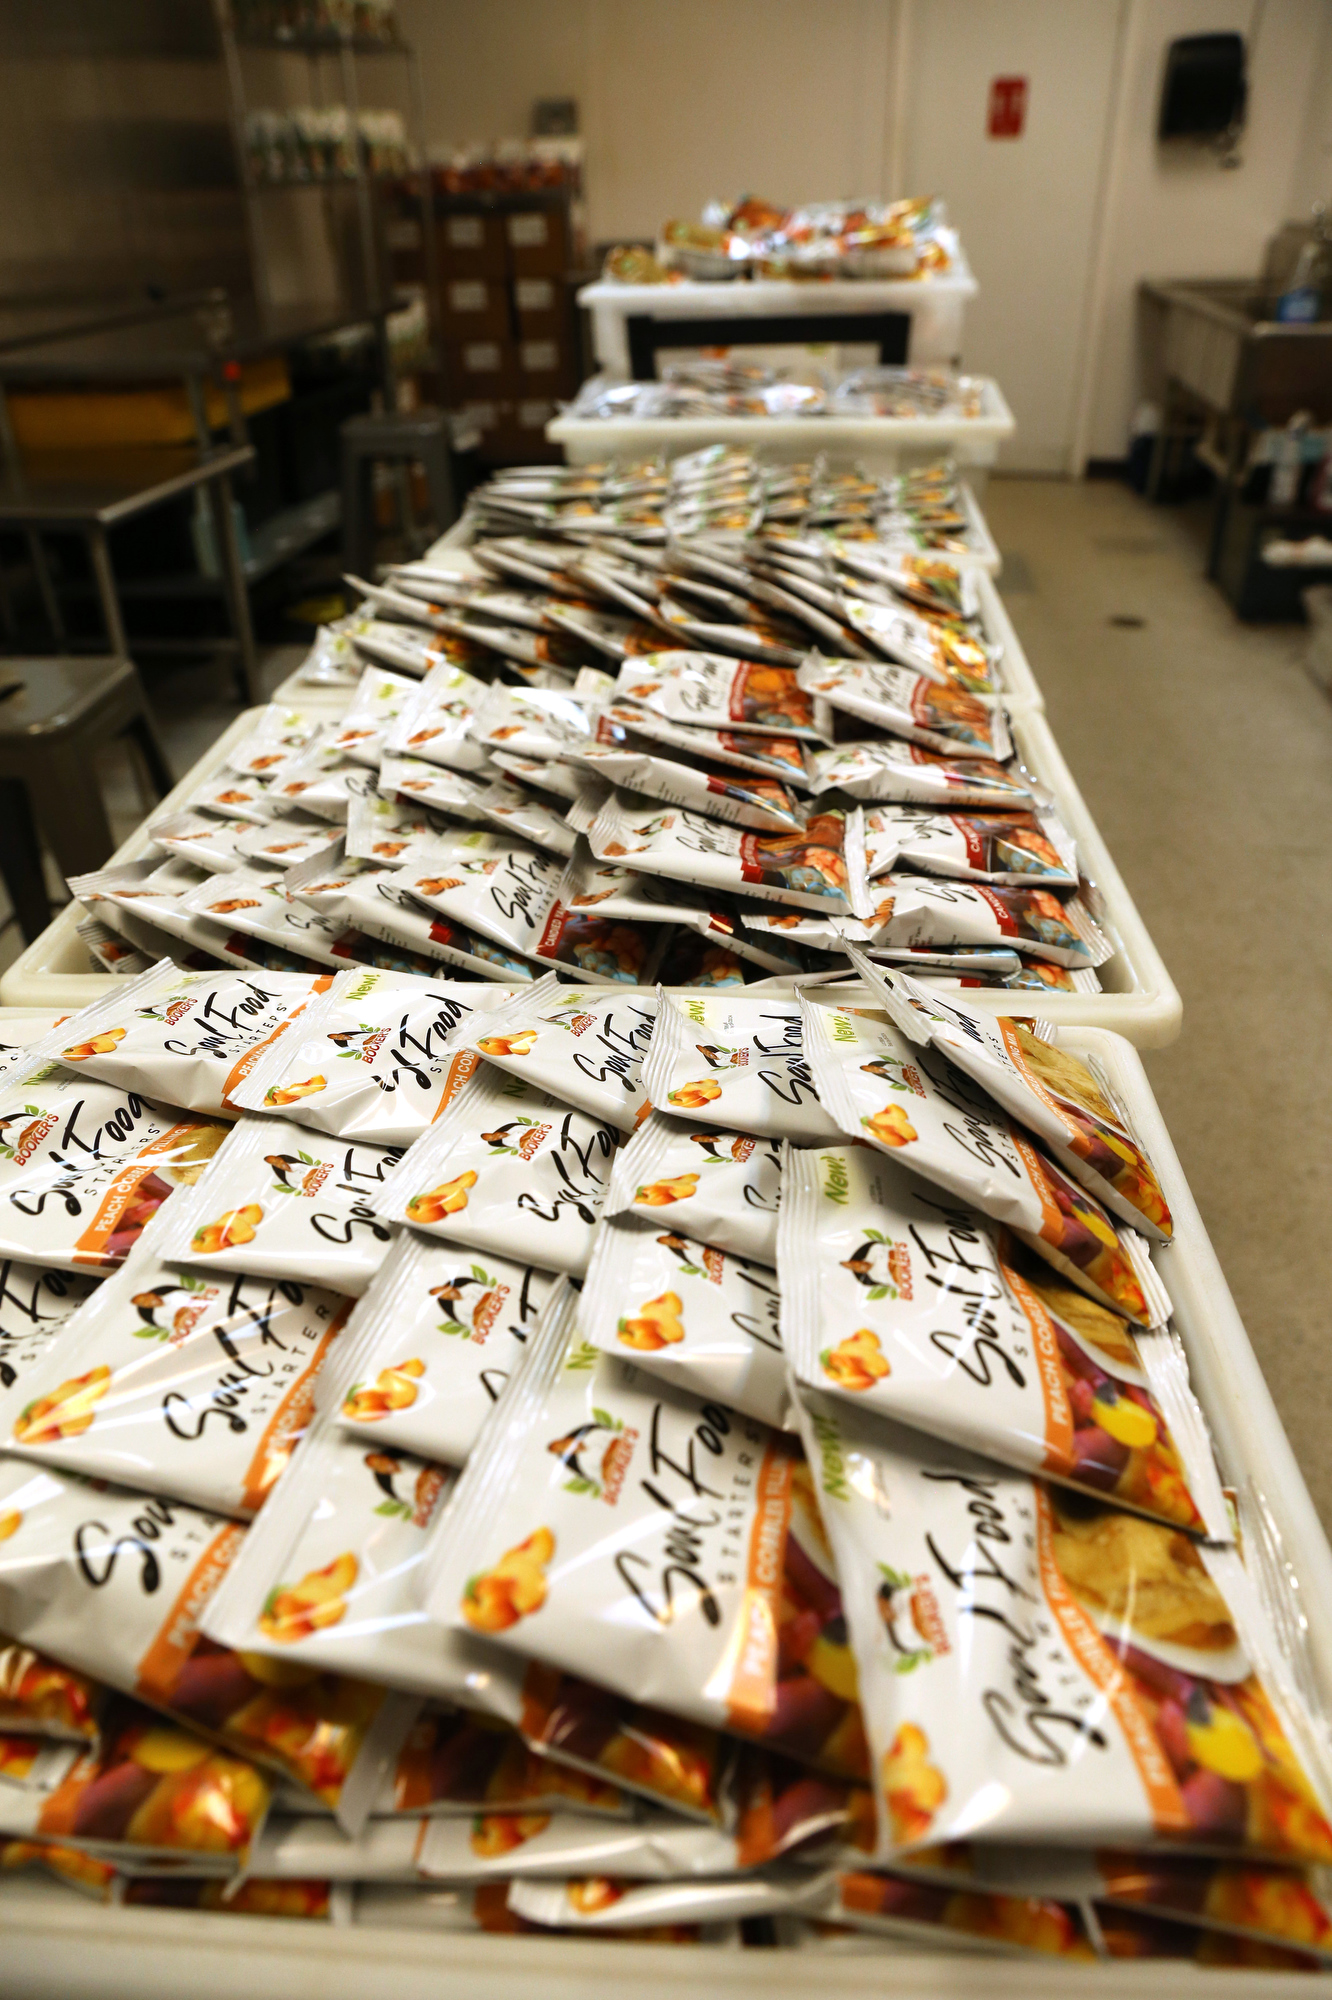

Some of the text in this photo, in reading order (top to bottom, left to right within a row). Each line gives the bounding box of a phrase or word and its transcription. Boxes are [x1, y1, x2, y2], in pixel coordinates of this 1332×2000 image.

[491, 868, 543, 929] Soul
[545, 918, 563, 947] CANDIED
[164, 998, 198, 1026] BOOKER'S
[346, 974, 381, 1001] New!
[164, 978, 283, 1059] Soul Food
[361, 1027, 392, 1064] BOOKER'S
[400, 993, 474, 1061] Food
[571, 1013, 598, 1037] BOOKER'S
[833, 1014, 858, 1043] New!
[573, 1034, 645, 1092] Soul
[1009, 1045, 1029, 1073] FILLING
[13, 1113, 59, 1167] BOOKER'S
[518, 1123, 553, 1161] BOOKER'S
[932, 1088, 1021, 1179] Soul
[303, 1163, 334, 1198] BOOKER'S
[821, 1155, 849, 1205] New!
[94, 1195, 127, 1232] PEACH
[895, 1242, 913, 1301] BOOKER'S
[470, 1283, 511, 1345] BOOKER'S
[930, 1274, 1026, 1389] Soul
[163, 1325, 274, 1440] Soul
[251, 1297, 336, 1414] STARTER
[614, 1480, 722, 1627] Soul
